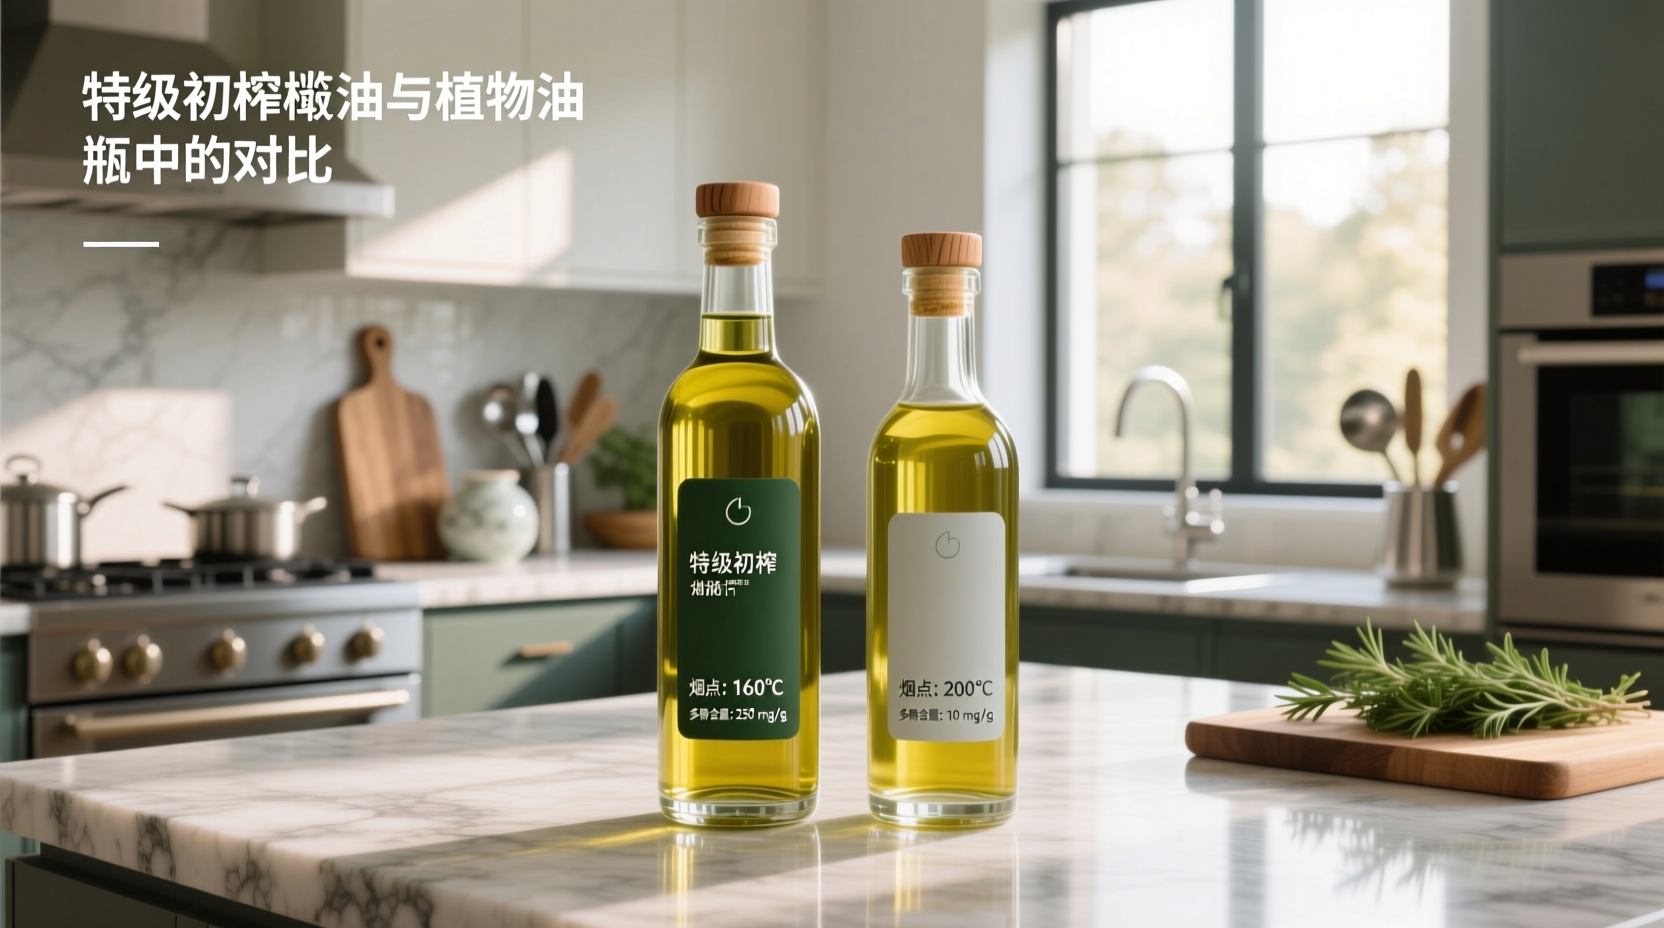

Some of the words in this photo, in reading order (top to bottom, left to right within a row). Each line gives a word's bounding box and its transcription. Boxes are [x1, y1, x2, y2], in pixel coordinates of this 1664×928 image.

[689, 550, 777, 575] 特级初榨
[733, 678, 784, 696] 160°C
[943, 679, 993, 697] 200°C
[757, 707, 788, 723] mg/g
[946, 709, 960, 721] 10
[962, 708, 994, 724] mg/g
